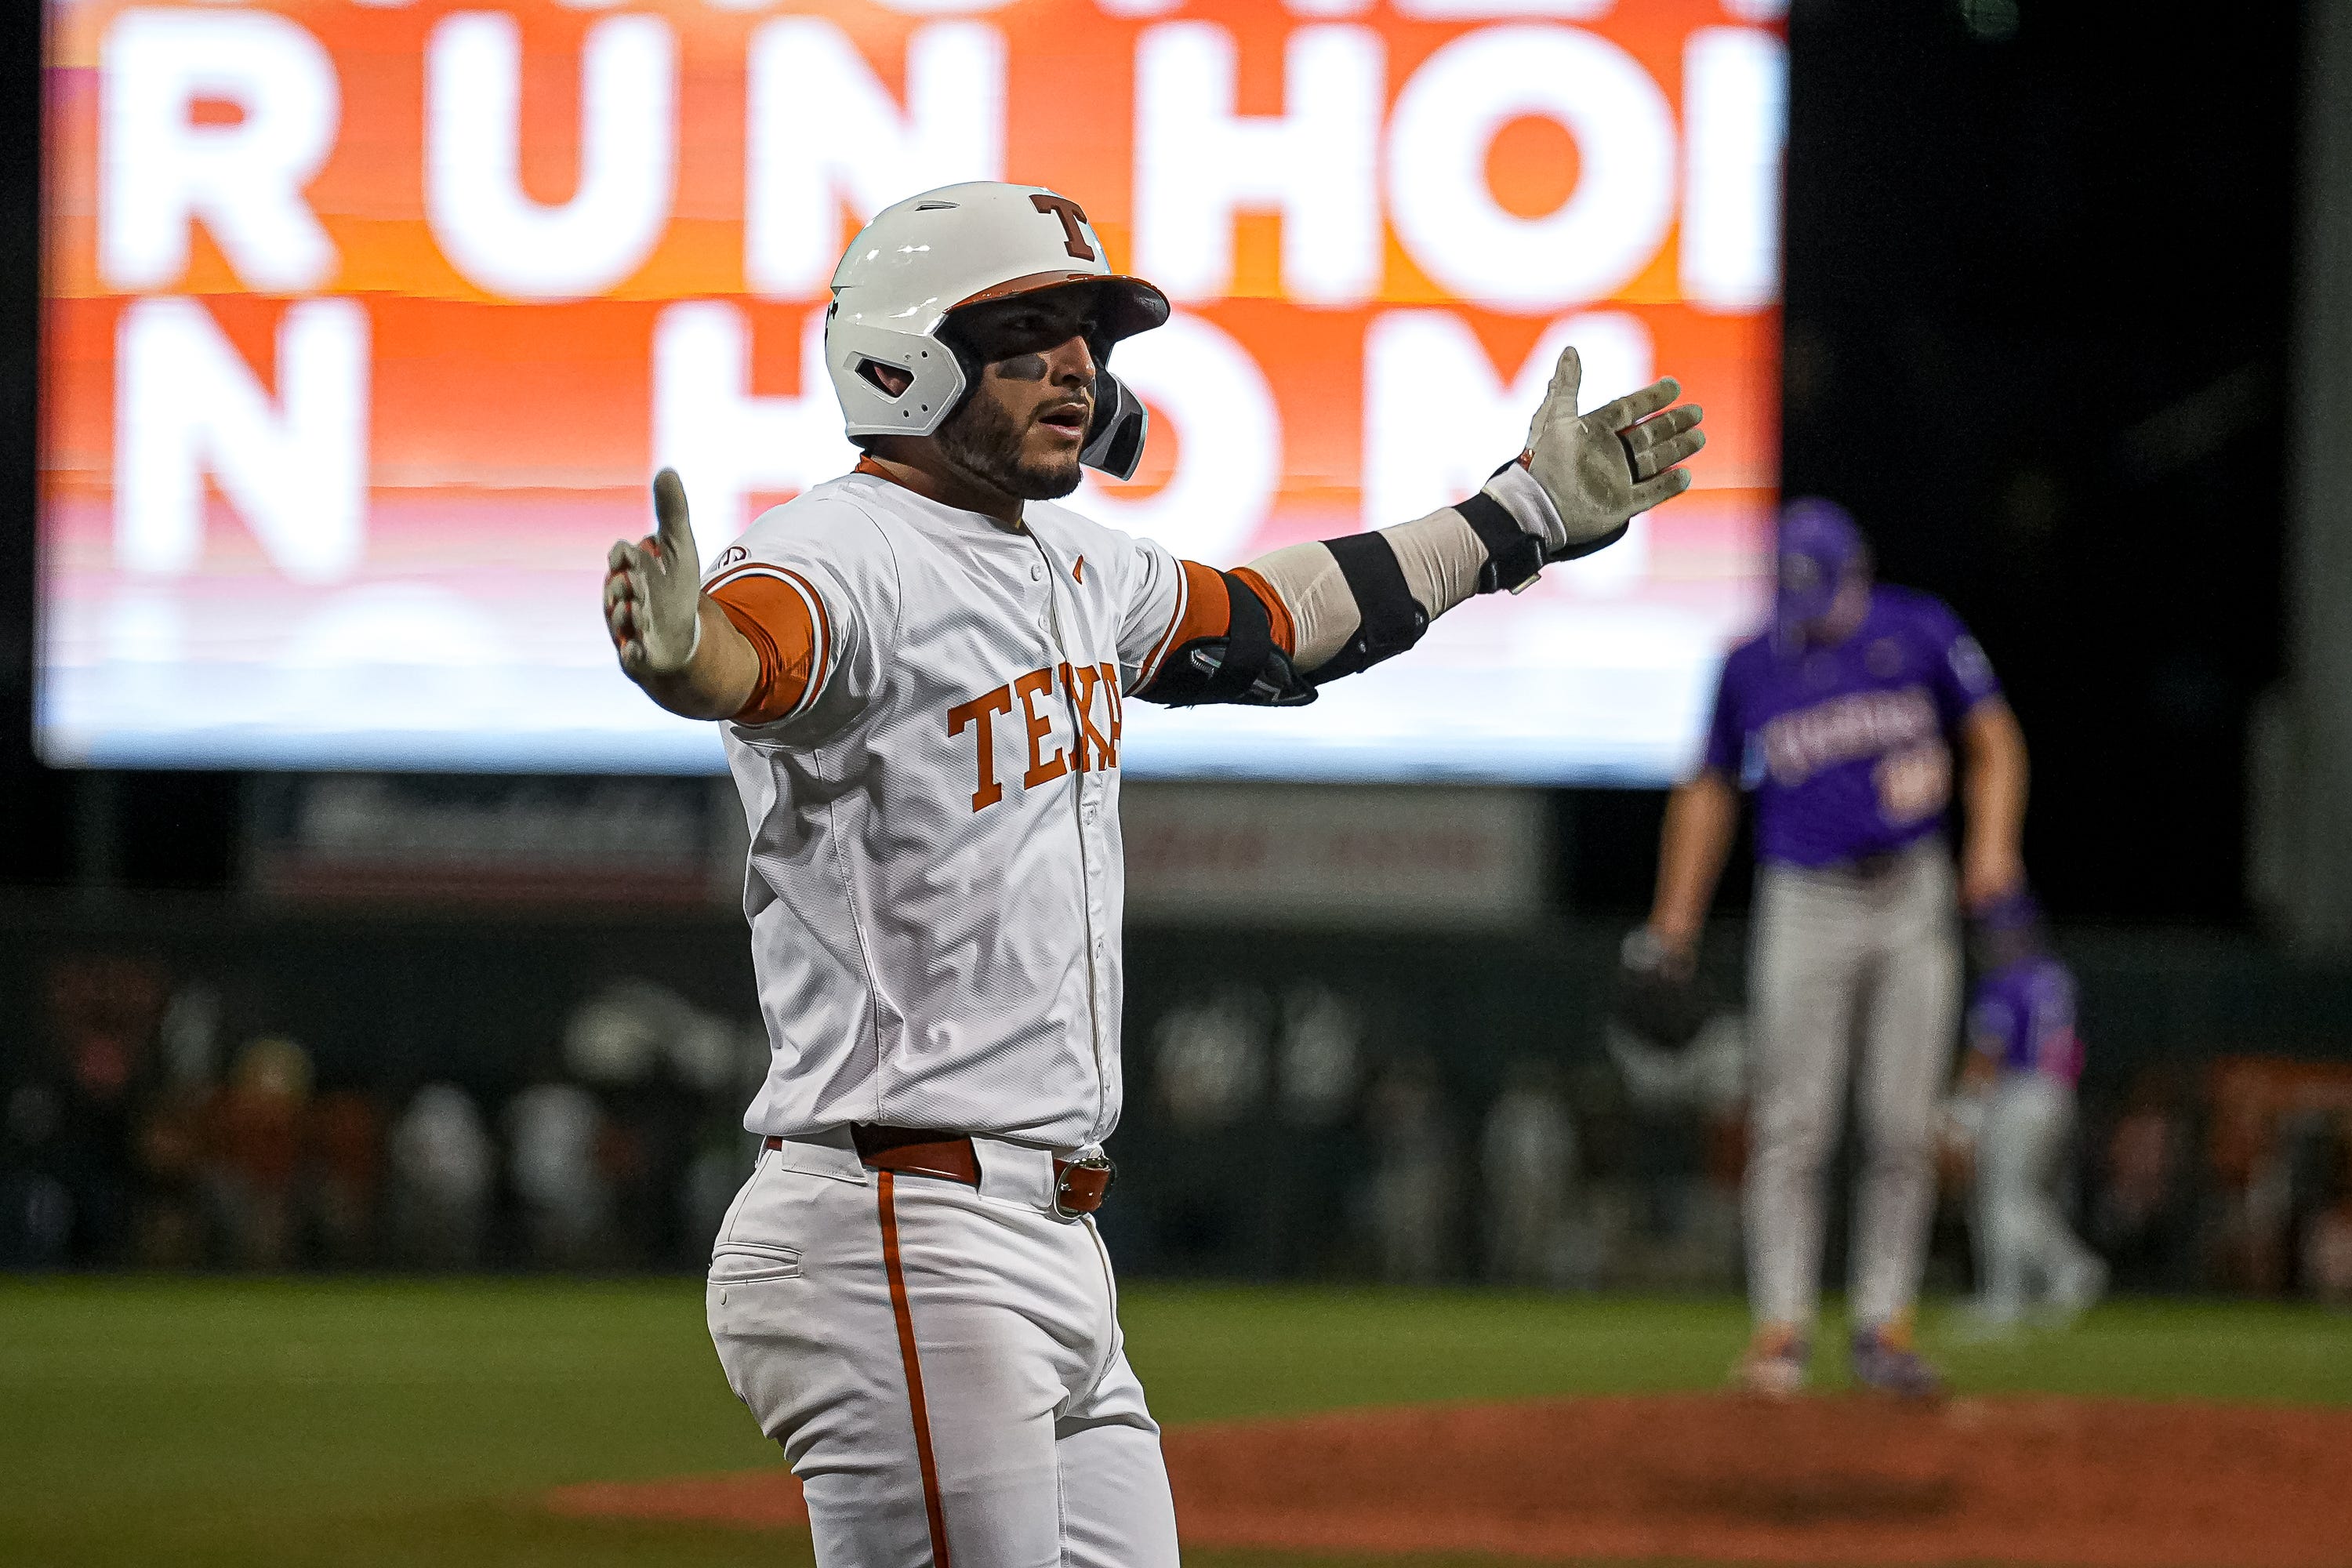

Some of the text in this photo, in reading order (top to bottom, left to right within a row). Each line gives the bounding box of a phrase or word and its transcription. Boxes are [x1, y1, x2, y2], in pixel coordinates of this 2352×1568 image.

[102, 11, 1007, 299] RUN
[1028, 194, 1095, 263] T
[118, 298, 367, 584] N
